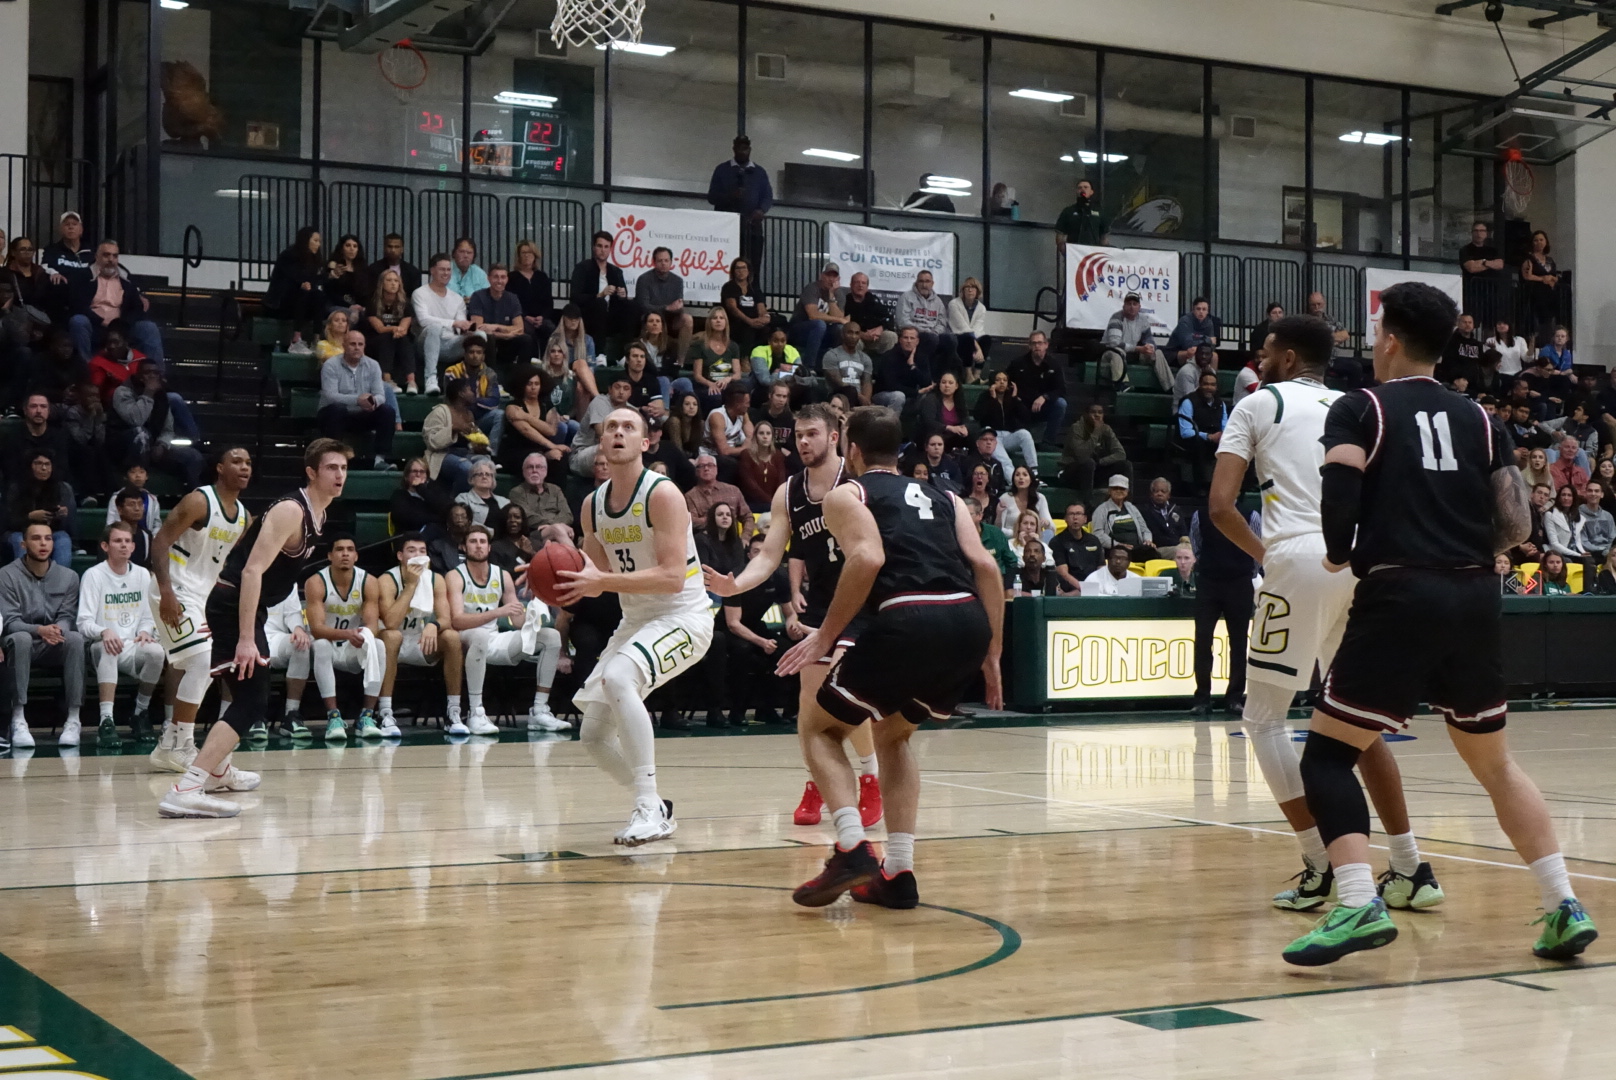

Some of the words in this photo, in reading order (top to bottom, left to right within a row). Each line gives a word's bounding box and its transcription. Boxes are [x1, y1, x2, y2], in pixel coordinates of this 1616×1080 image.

[840, 251, 865, 263] CUI
[869, 255, 943, 270] ATHLETICS
[878, 270, 915, 279] SONESTA
[1107, 264, 1170, 277] NATIONAL
[1107, 274, 1170, 291] SPORTS
[1414, 410, 1459, 471] 11
[904, 482, 935, 520] 4
[334, 616, 350, 630] 10
[402, 617, 417, 630] 14
[1250, 591, 1291, 655] C
